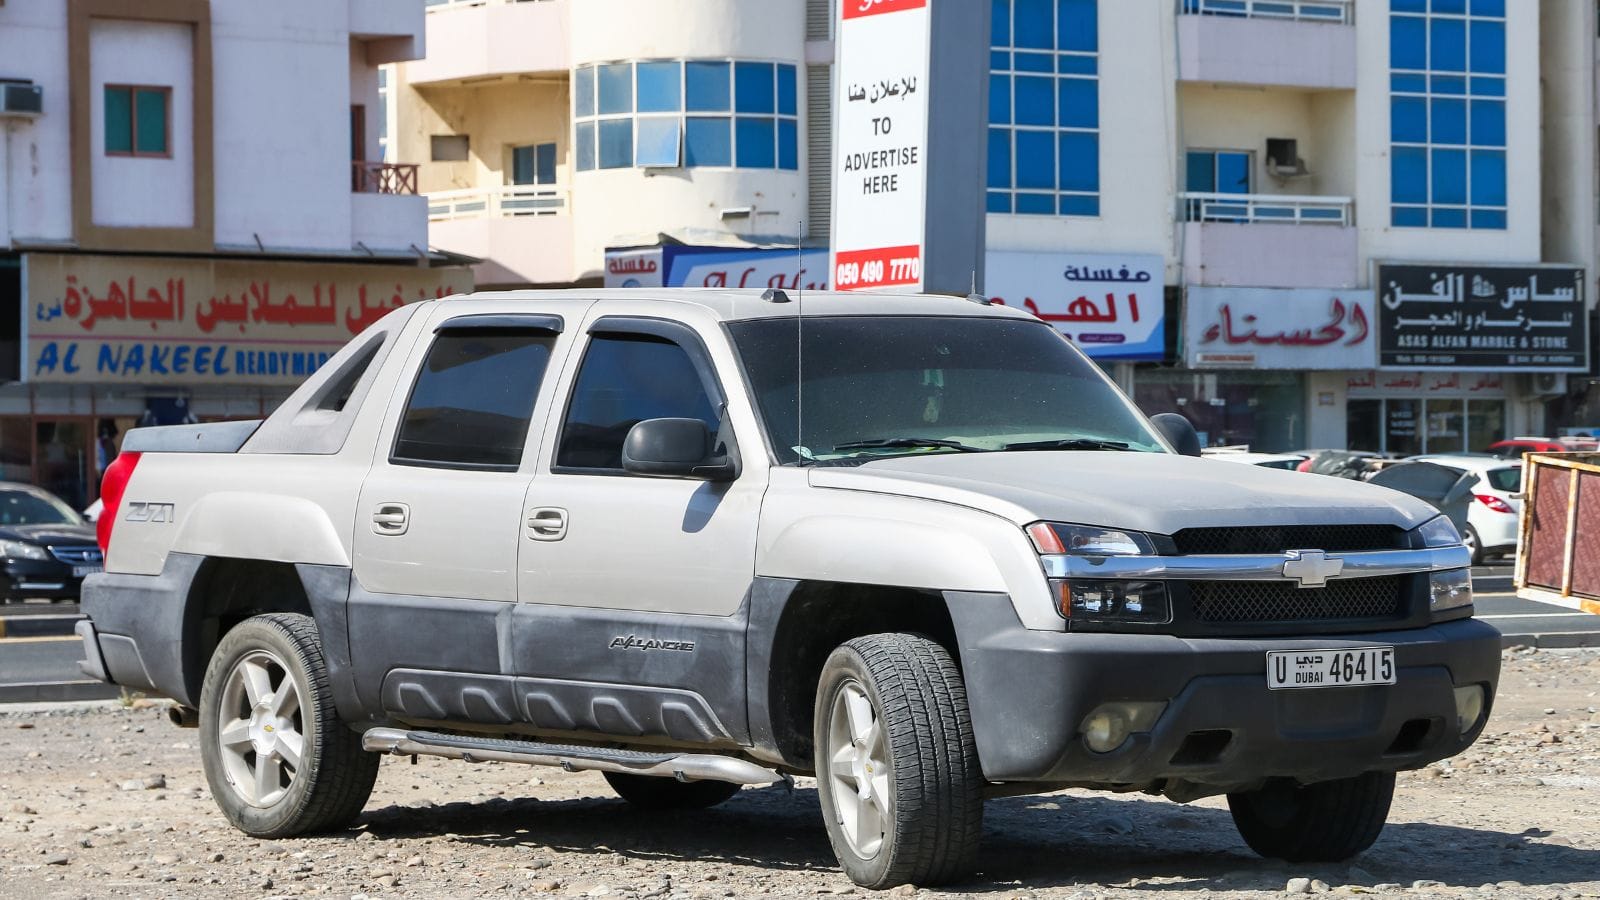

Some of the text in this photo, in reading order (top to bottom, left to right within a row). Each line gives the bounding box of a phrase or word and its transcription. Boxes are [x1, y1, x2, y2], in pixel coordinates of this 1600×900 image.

[848, 76, 917, 104] للإعلان هنا
[872, 116, 892, 136] TO
[844, 146, 918, 172] ADVERTISE
[863, 174, 898, 195] HERE
[608, 257, 658, 275] مغسلة
[837, 257, 919, 286] 050 490 7770
[1064, 265, 1152, 283] مغسلة
[63, 275, 185, 331] الجاهزة
[1383, 271, 1584, 310] أساس الفن
[195, 280, 337, 334] للملابس
[1199, 298, 1369, 346] الحسناء
[1397, 335, 1428, 348] ASAS
[1432, 335, 1468, 348] ALFAN
[1471, 335, 1517, 348] MARBLE
[1532, 336, 1568, 348] STONE
[35, 342, 81, 376] AL
[97, 343, 230, 376] NAKEEL
[125, 501, 175, 524] Z71
[608, 633, 695, 652] AVALANCHE
[1275, 656, 1287, 684] U
[1295, 656, 1323, 669] دبي
[1329, 650, 1393, 683] 46415
[1295, 671, 1323, 684] DUBAI
